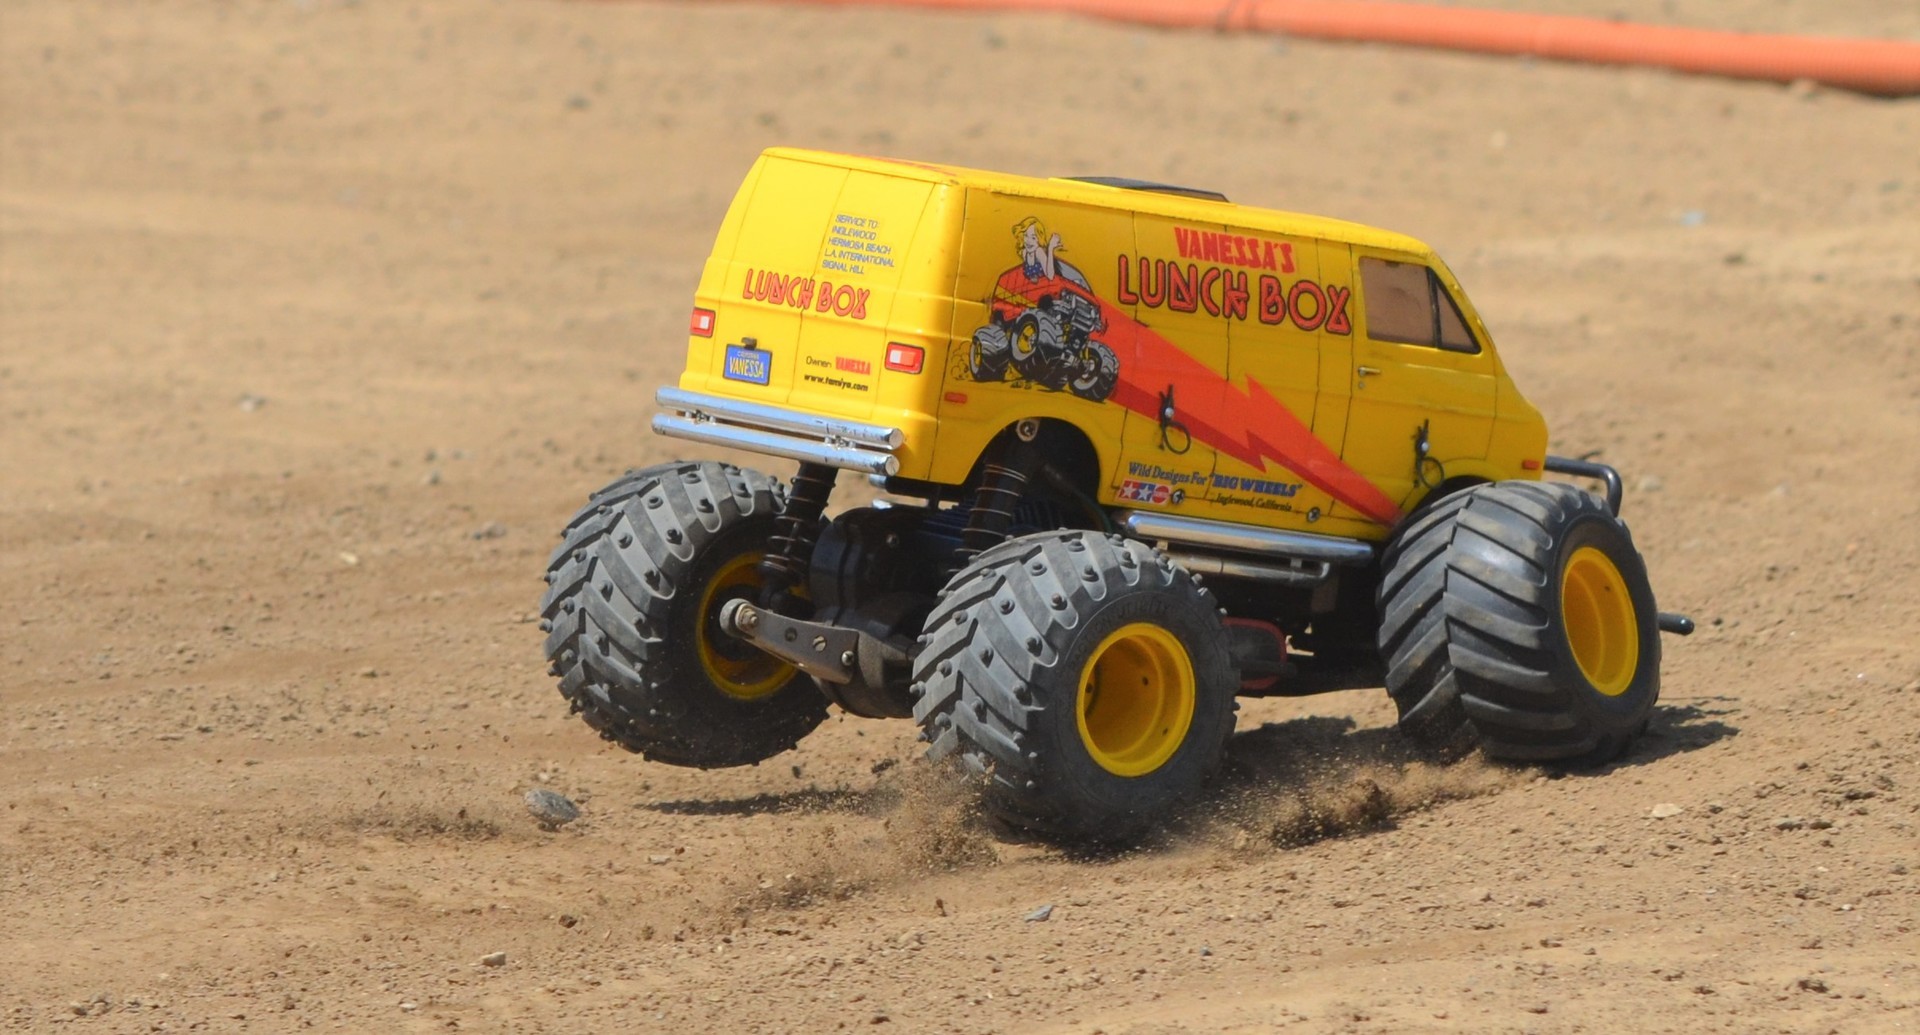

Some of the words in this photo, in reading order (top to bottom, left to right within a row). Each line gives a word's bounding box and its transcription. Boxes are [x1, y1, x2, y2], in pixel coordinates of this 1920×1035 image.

[835, 214, 867, 228] SERVICE
[832, 226, 877, 241] INGLEWOOD
[828, 237, 864, 251] HERMOSA
[866, 243, 891, 254] BEACH
[1174, 227, 1295, 273] VANESSA'S
[822, 260, 849, 273] SIGNAL
[849, 265, 865, 275] HILL
[838, 250, 895, 267] INTERNATIONAL
[743, 269, 815, 310] LUNCH
[816, 281, 870, 320] BOX
[1118, 254, 1250, 321] LUNCH
[1259, 274, 1351, 335] BOX
[729, 356, 765, 379] VANESSA
[835, 356, 871, 375] VANESSA
[1128, 462, 1150, 477] Wild
[1151, 466, 1190, 485] Designs
[1190, 471, 1207, 486] For
[1256, 498, 1292, 512] California
